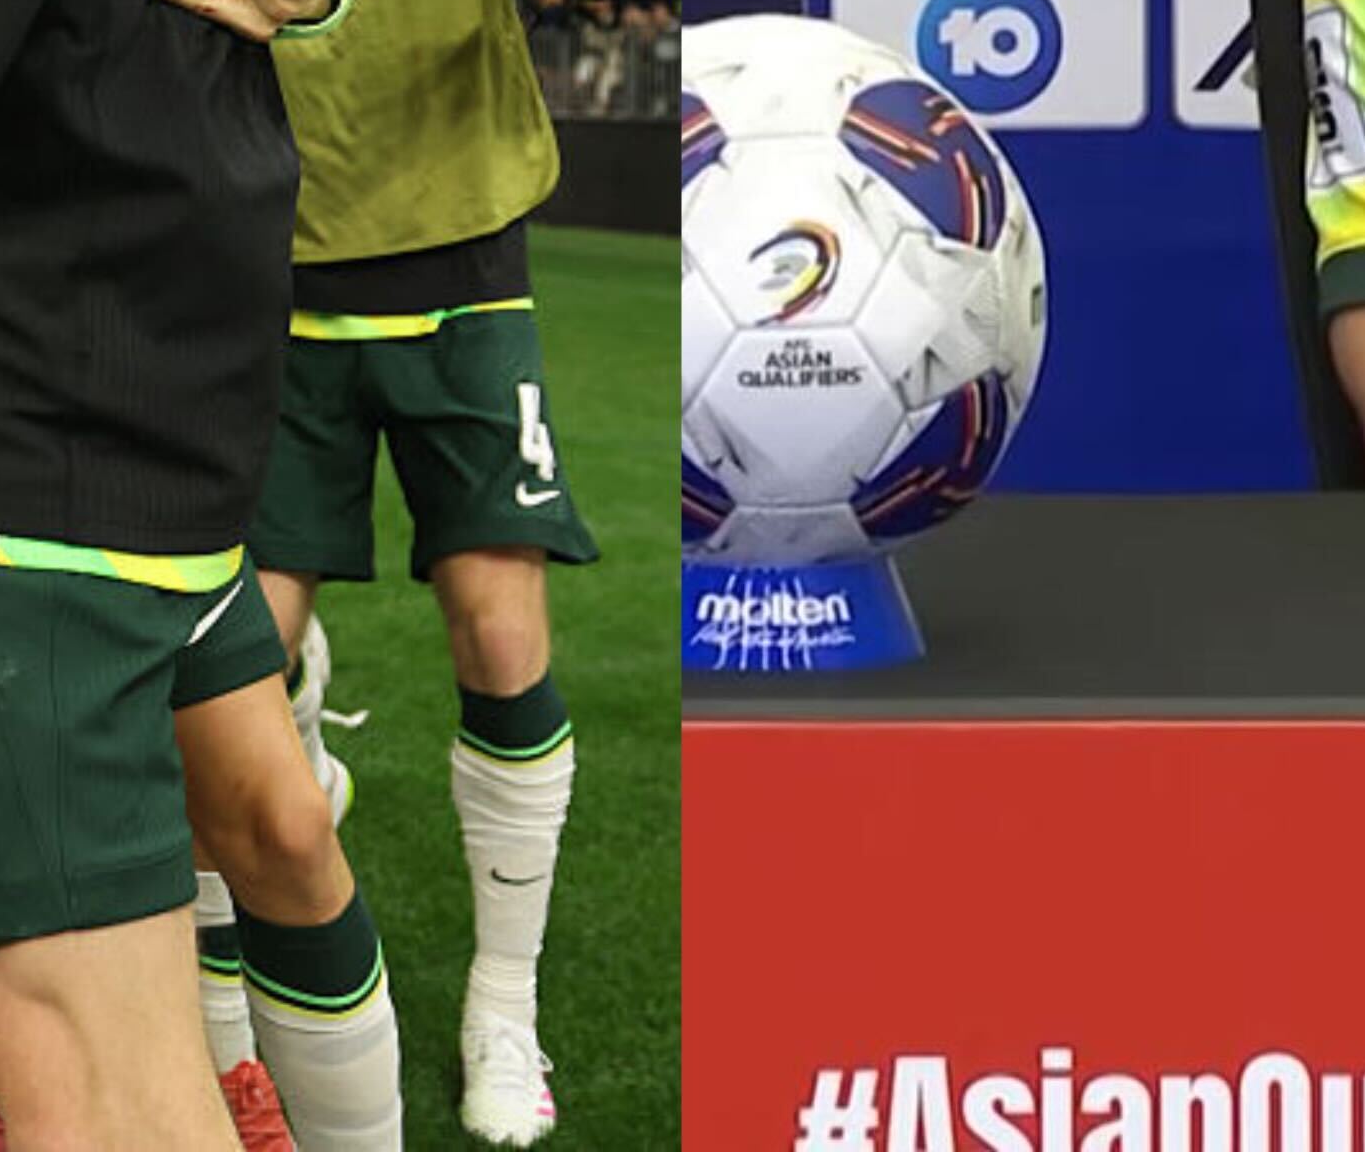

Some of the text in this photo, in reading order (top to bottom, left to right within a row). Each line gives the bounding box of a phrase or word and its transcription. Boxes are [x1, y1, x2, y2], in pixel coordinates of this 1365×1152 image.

[939, 6, 1040, 78] 10
[765, 350, 832, 367] ASIAN
[737, 367, 863, 388] QUALIFIERS
[517, 382, 556, 481] 4
[695, 591, 852, 627] molten
